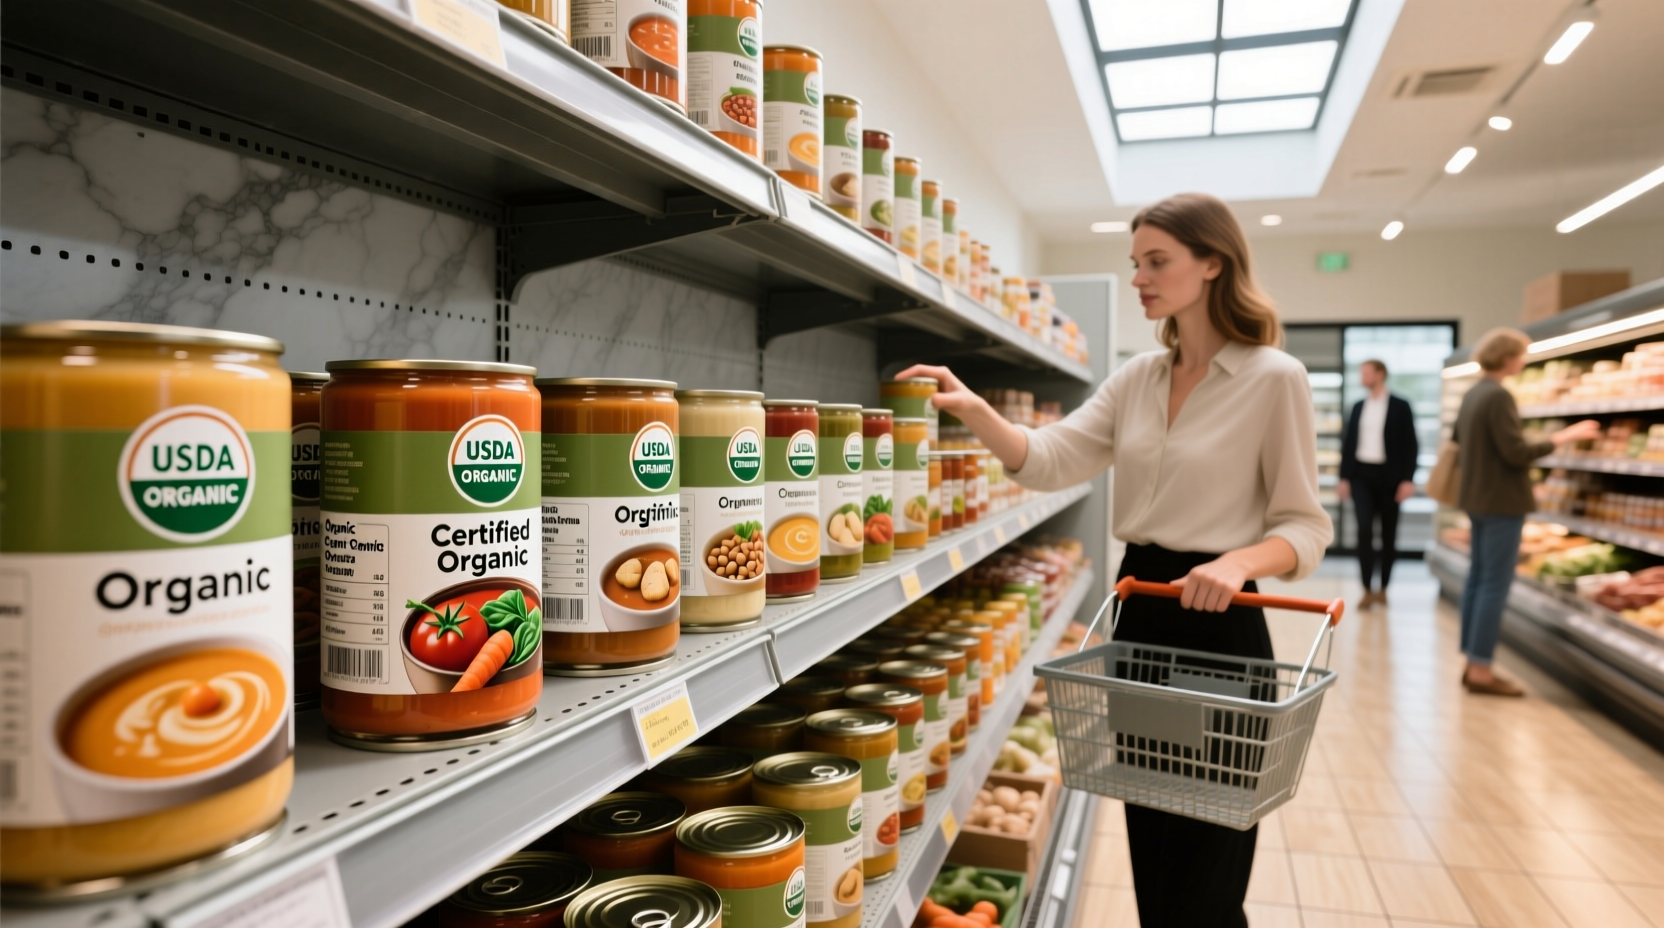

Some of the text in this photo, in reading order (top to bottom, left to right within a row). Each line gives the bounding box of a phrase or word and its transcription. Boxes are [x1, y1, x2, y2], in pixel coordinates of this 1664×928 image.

[153, 443, 235, 472] USDA
[291, 444, 320, 462] USD
[466, 440, 514, 460] USDA
[642, 442, 670, 457] USDA
[461, 469, 517, 483] ORGANIC
[143, 483, 239, 508] ORGANIC
[431, 518, 530, 547] Certified
[437, 545, 529, 577] Organic
[95, 559, 271, 615] Organic
